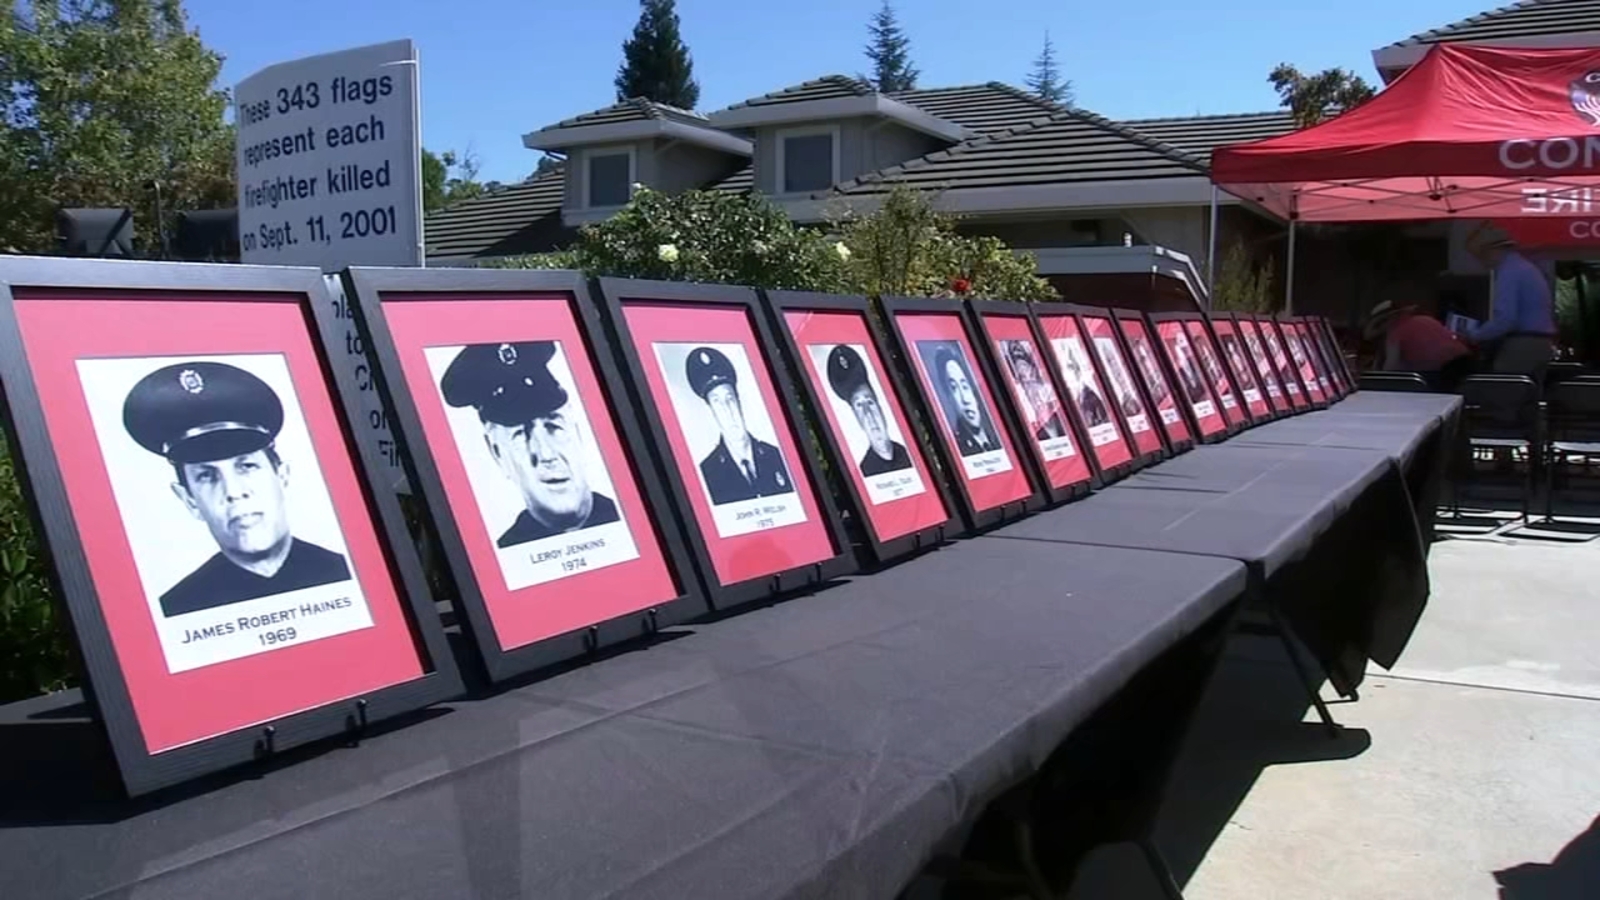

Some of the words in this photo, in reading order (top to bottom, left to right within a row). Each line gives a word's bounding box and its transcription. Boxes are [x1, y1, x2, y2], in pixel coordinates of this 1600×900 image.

[277, 82, 320, 115] 343
[331, 75, 393, 105] flags
[244, 126, 316, 168] represent
[326, 114, 384, 148] each
[244, 175, 318, 209] firefighter
[327, 159, 390, 195] killed
[242, 232, 256, 251] on
[259, 220, 298, 252] Sept.
[306, 214, 331, 245] 11,
[340, 205, 396, 239] 2001
[530, 549, 562, 564] LEROY
[565, 538, 605, 556] JENKINS
[561, 558, 587, 571] 1974
[181, 622, 235, 644] JAMES
[236, 608, 297, 631] ROBERT
[299, 596, 352, 617] HAINES
[258, 626, 297, 646] 1969
